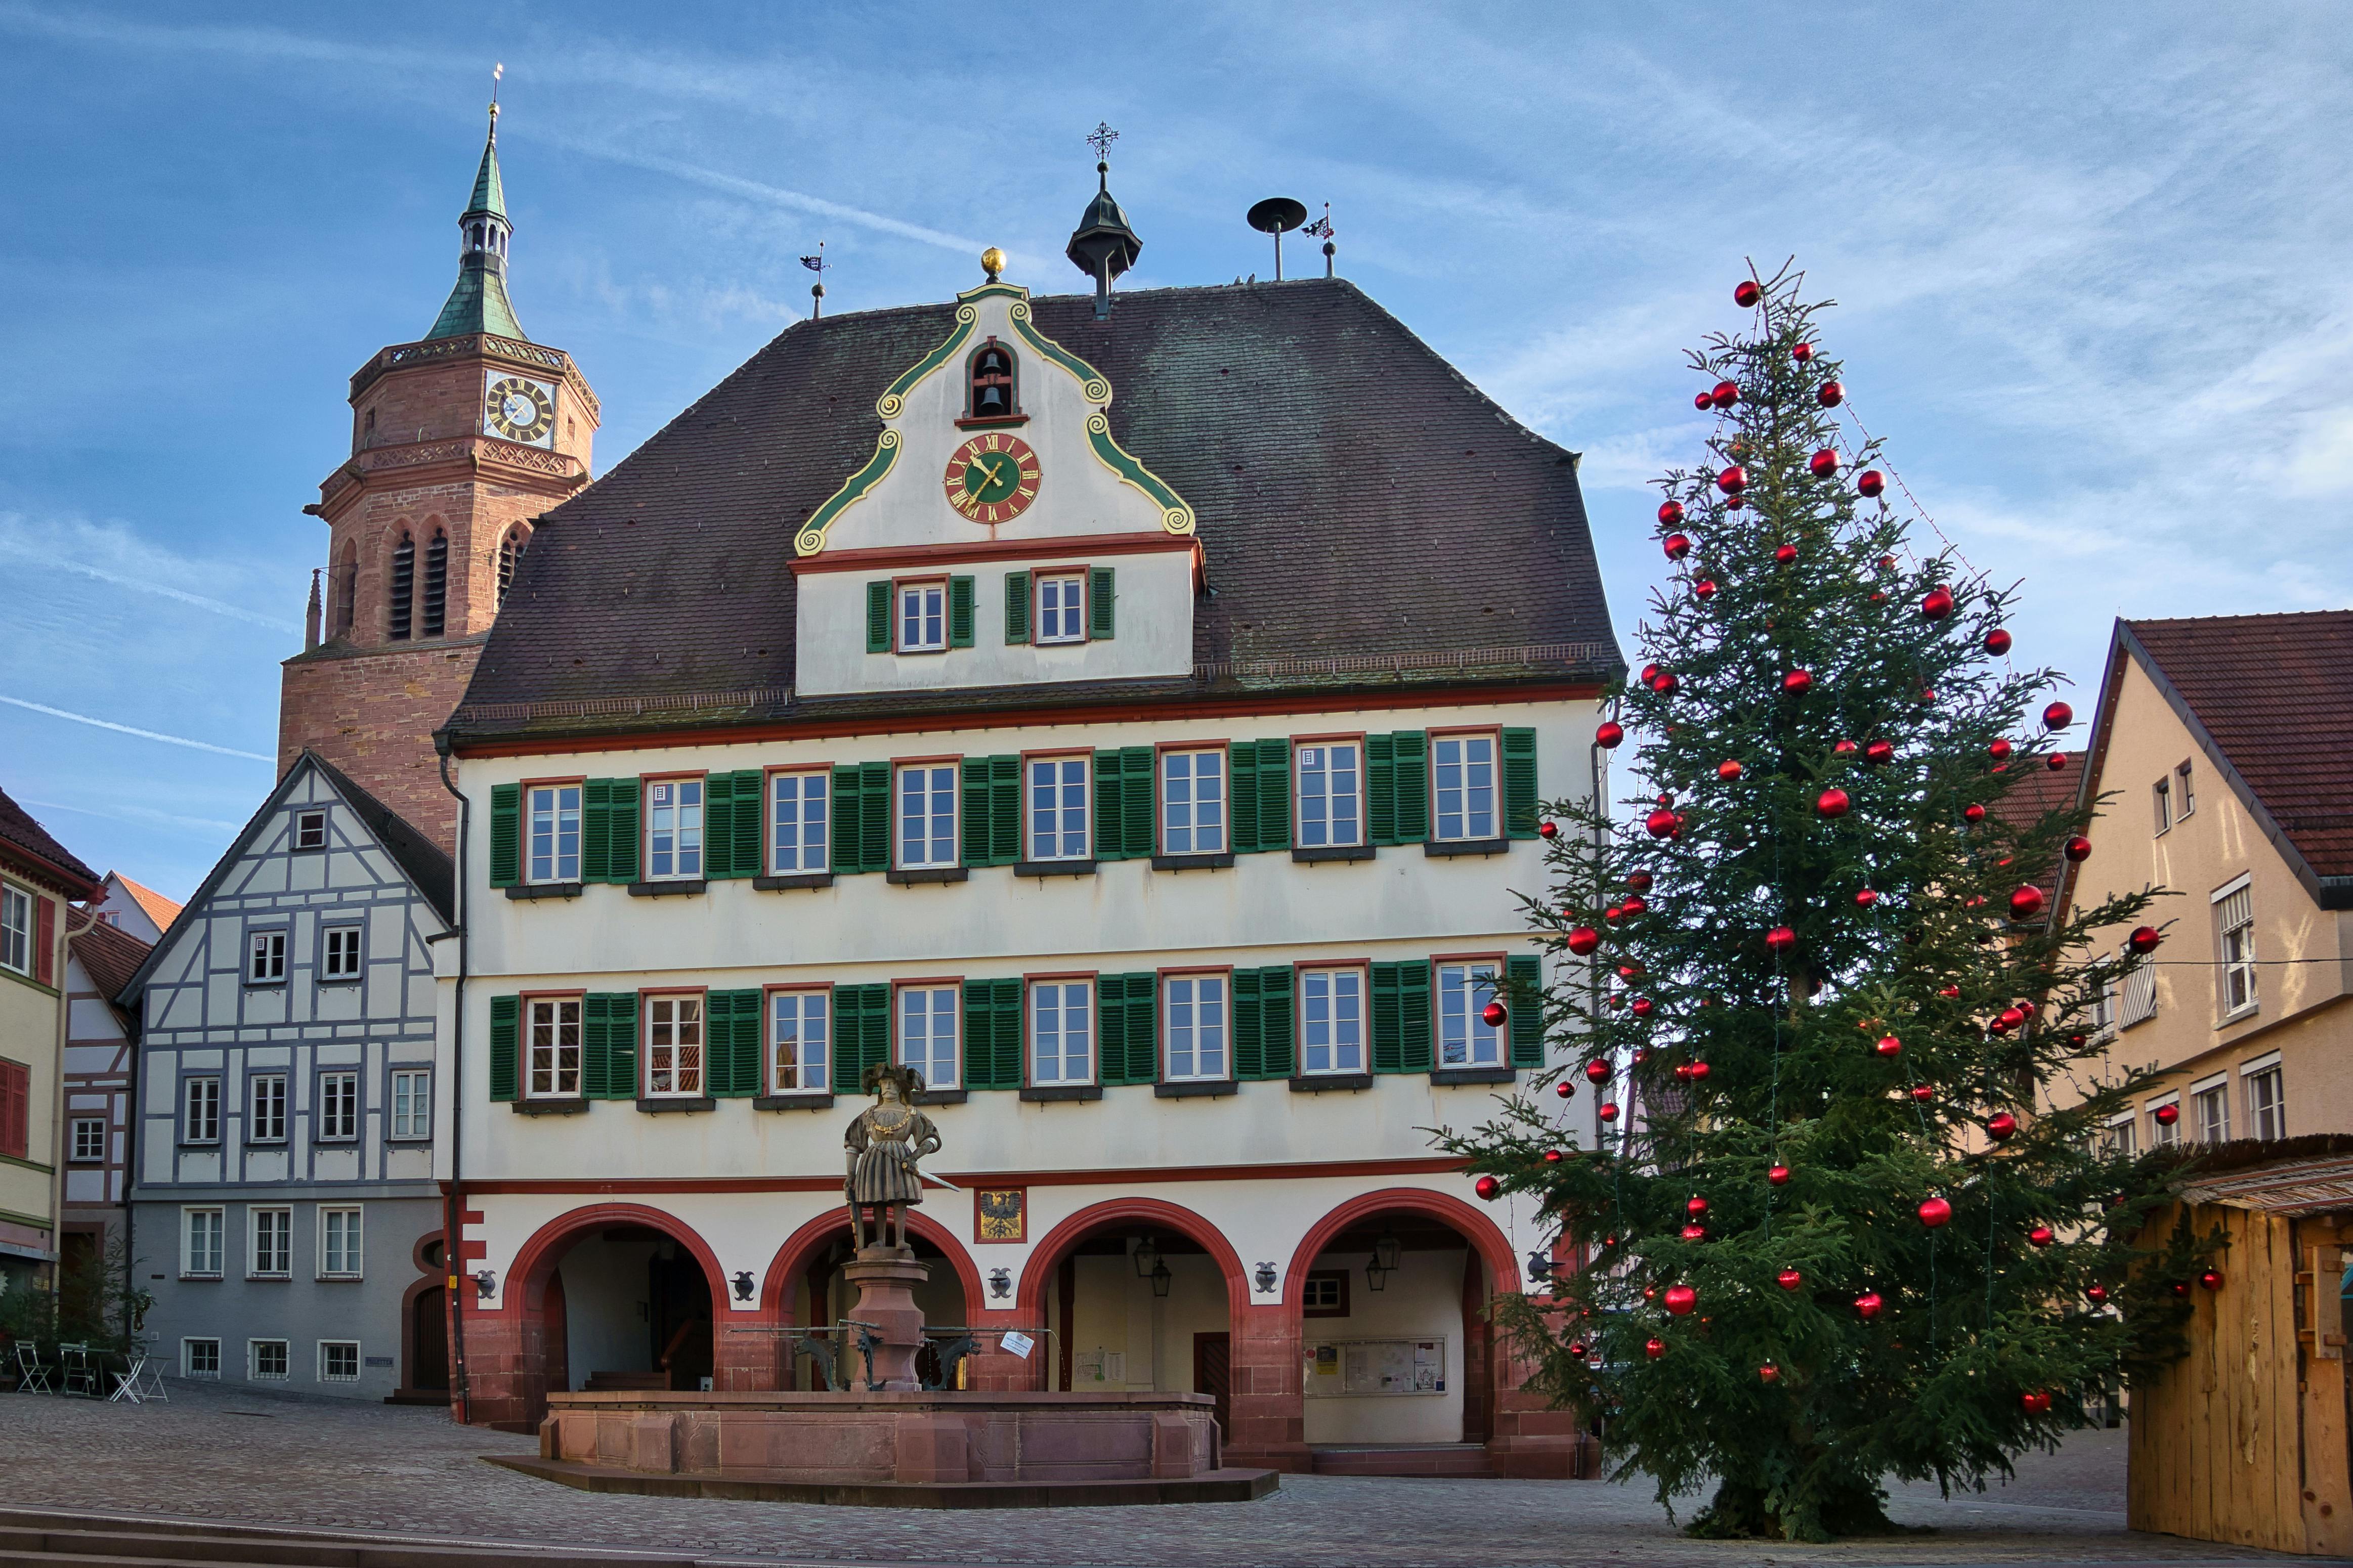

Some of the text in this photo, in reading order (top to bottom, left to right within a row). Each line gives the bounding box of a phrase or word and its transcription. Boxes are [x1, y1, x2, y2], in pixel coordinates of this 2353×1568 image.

[965, 441, 980, 456] XI
[986, 435, 998, 450] XII
[1006, 439, 1016, 452] I
[952, 457, 968, 469] X
[1017, 451, 1033, 464] II
[947, 475, 963, 486] IX
[1022, 469, 1038, 480] III
[950, 488, 968, 508] VIII
[1018, 486, 1035, 500] IV
[988, 505, 998, 521] VI
[1008, 502, 1019, 515] V
